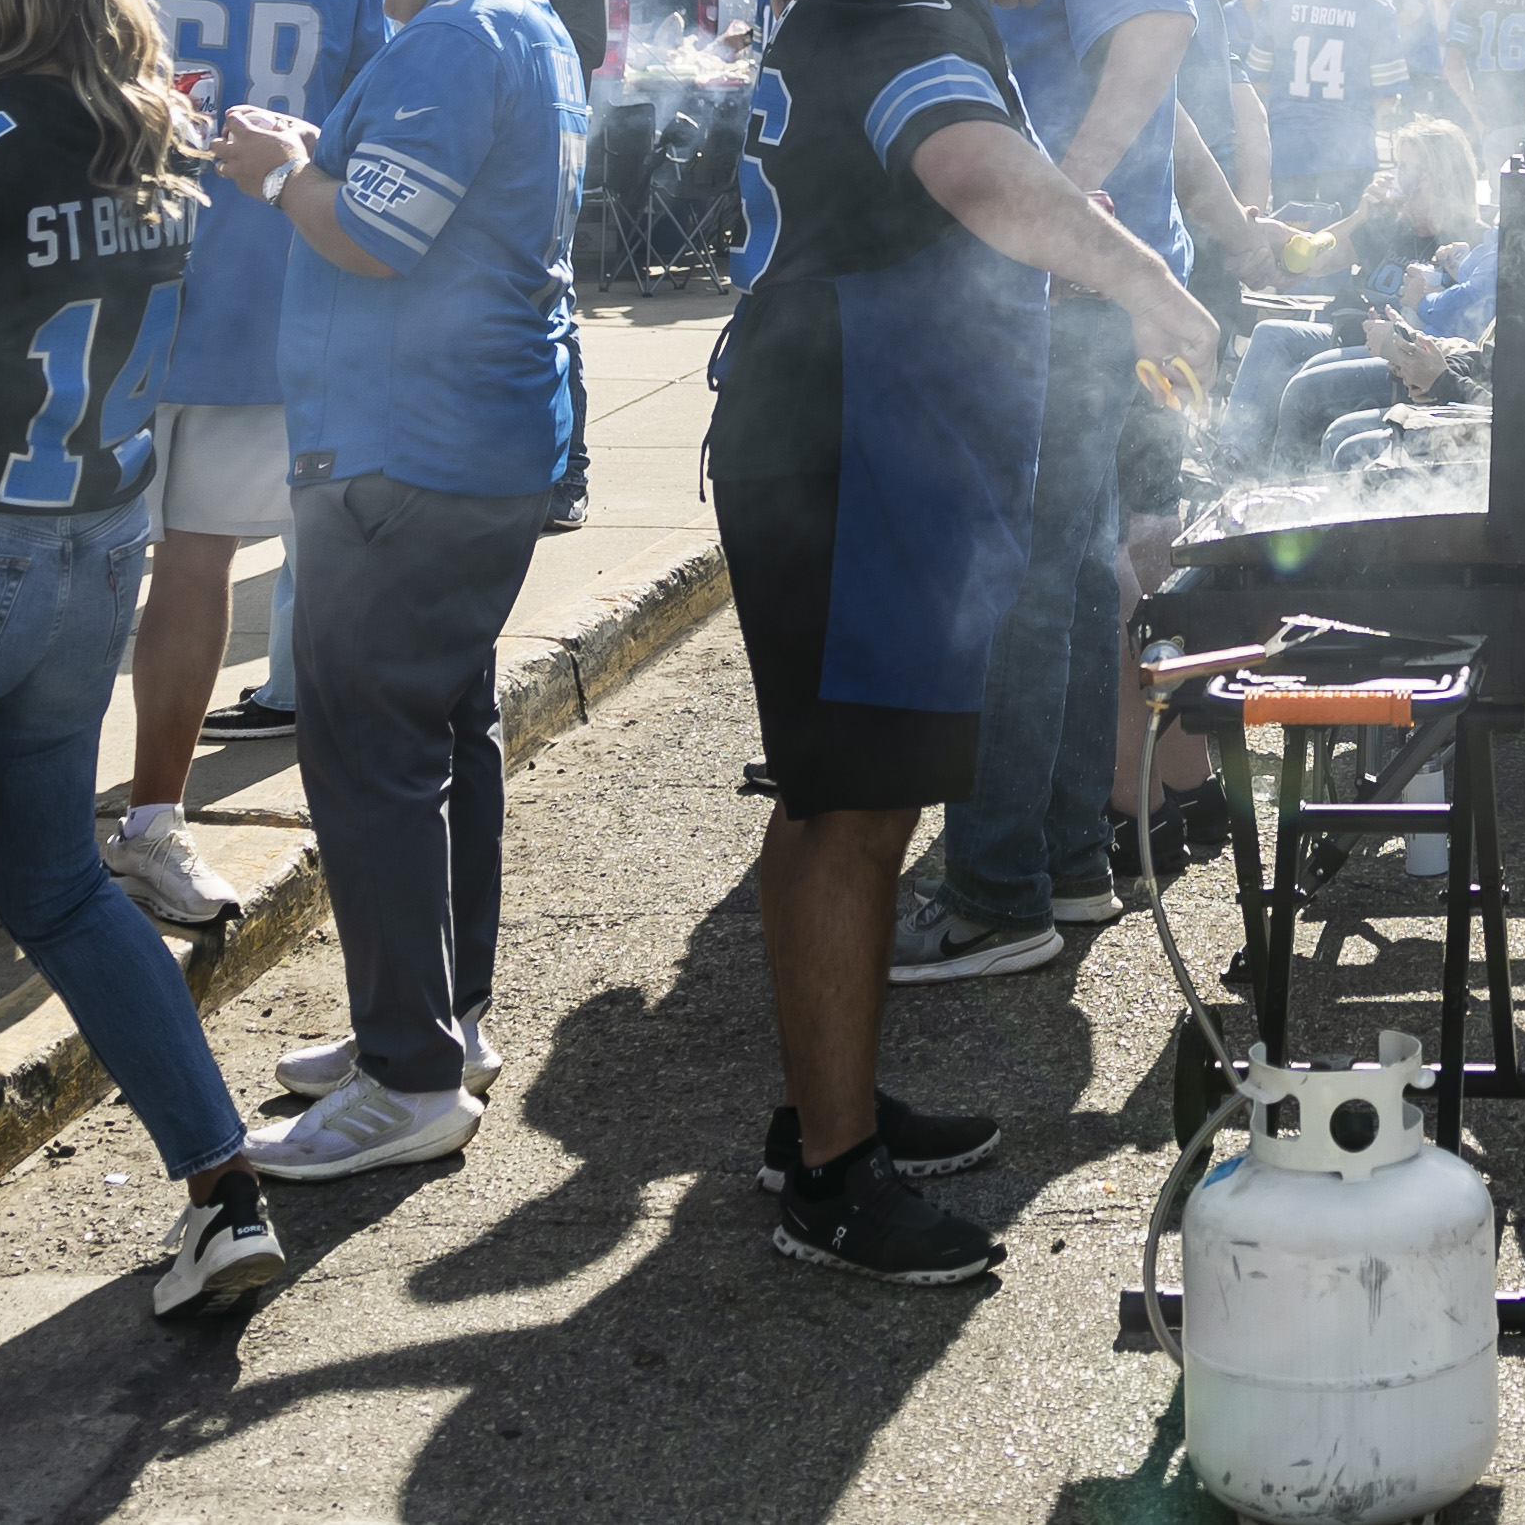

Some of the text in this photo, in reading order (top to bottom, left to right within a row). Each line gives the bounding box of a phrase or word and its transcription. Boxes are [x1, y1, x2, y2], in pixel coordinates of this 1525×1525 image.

[1290, 4, 1357, 29] ST BROWN
[1289, 35, 1345, 101] 14
[348, 164, 420, 208] WCF
[27, 200, 82, 268] ST
